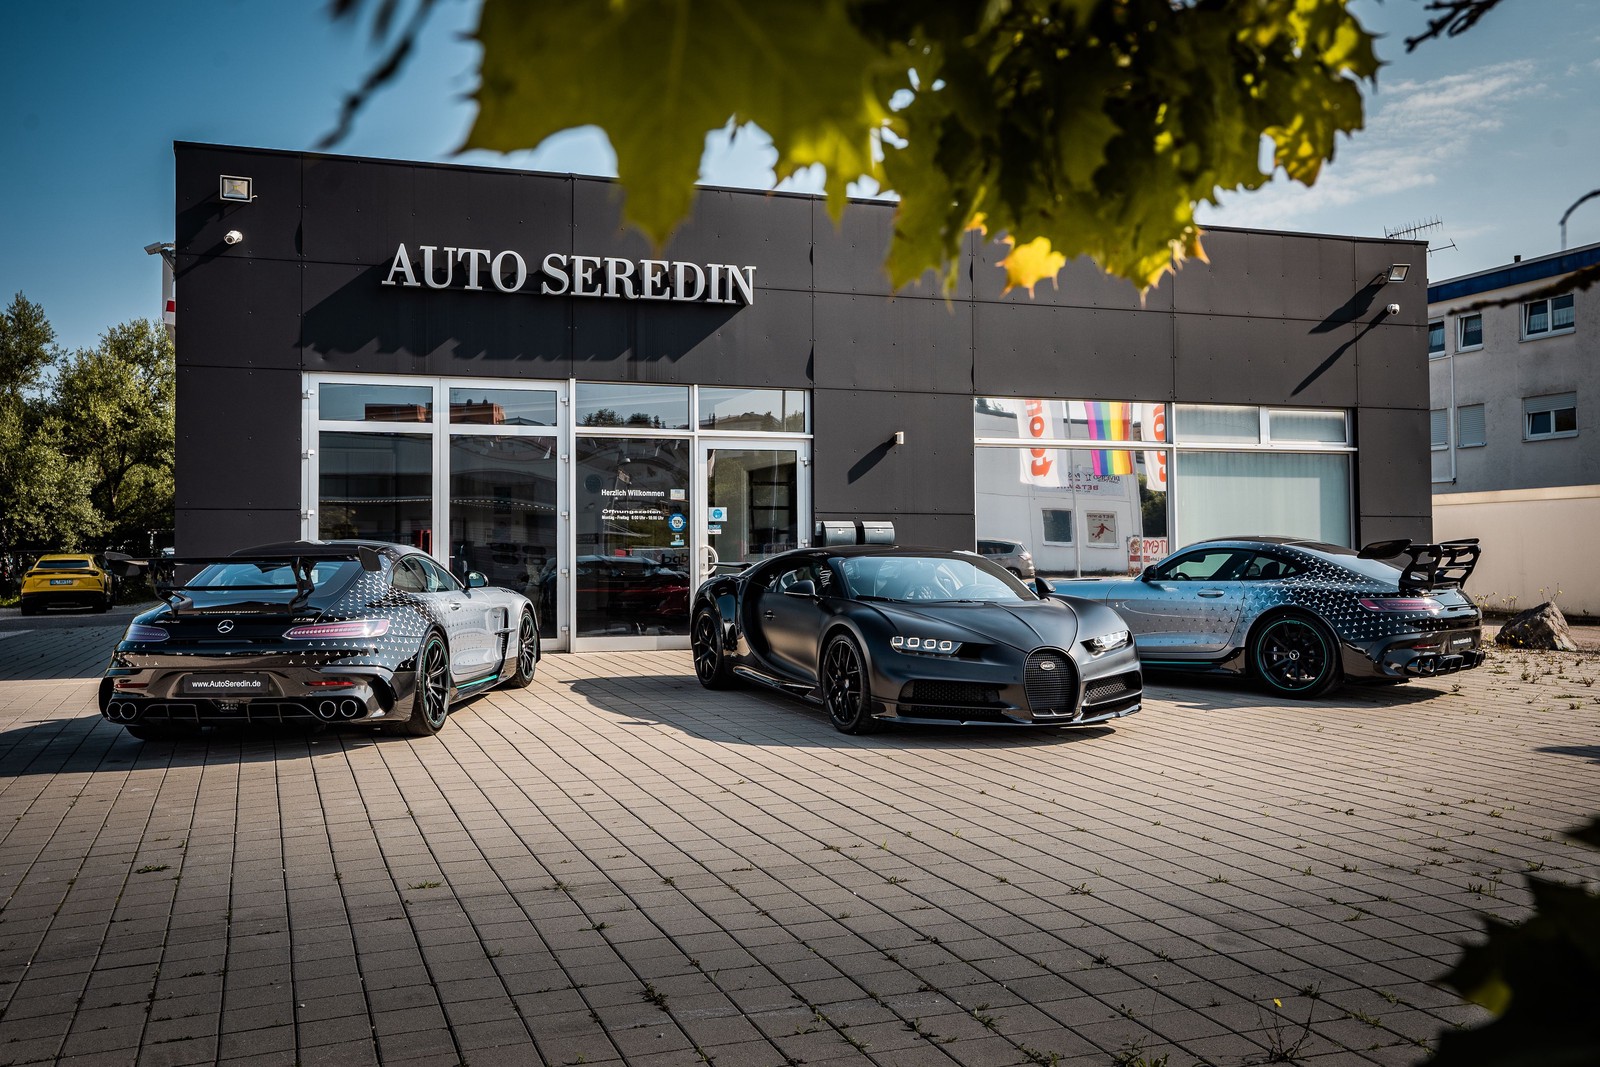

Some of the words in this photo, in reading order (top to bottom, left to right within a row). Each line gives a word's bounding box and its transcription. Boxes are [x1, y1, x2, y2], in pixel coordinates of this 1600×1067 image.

[381, 242, 527, 294] AUTO
[540, 252, 757, 306] SEREDIN
[601, 489, 627, 497] Herzlich
[627, 489, 665, 497] Willkommen
[192, 679, 262, 688] www.AutoSeredin.de
